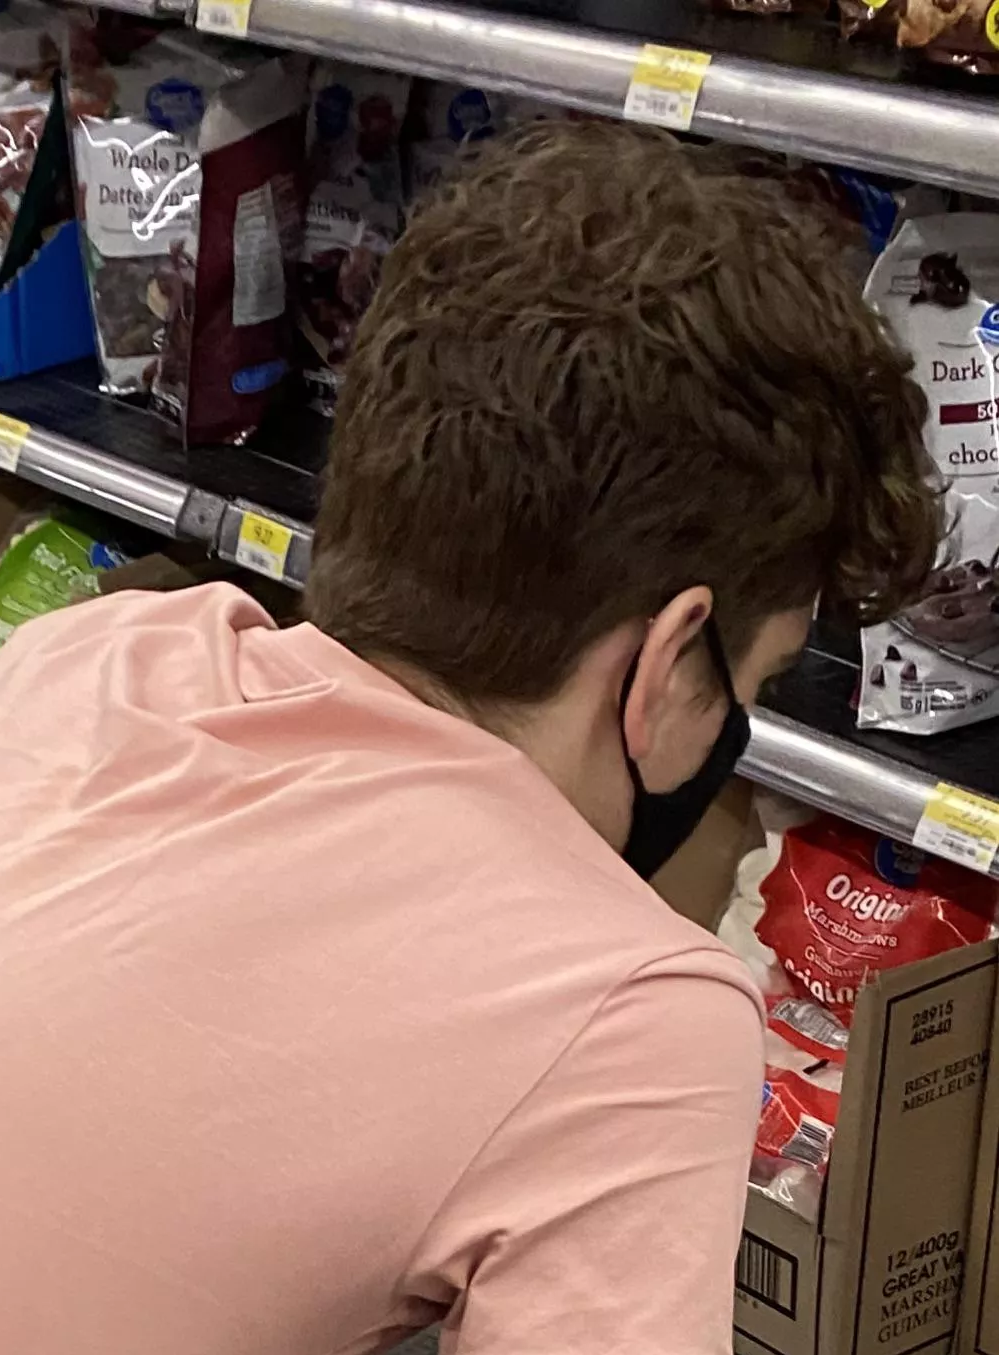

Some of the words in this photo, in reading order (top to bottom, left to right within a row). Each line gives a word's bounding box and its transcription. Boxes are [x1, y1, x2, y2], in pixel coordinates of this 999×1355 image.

[111, 148, 170, 172] Whole
[932, 358, 985, 382] Dark
[805, 900, 898, 947] Marshmows
[901, 1071, 976, 1113] MEILLEUR
[904, 1068, 941, 1096] BEST
[882, 1258, 939, 1298] GREAT
